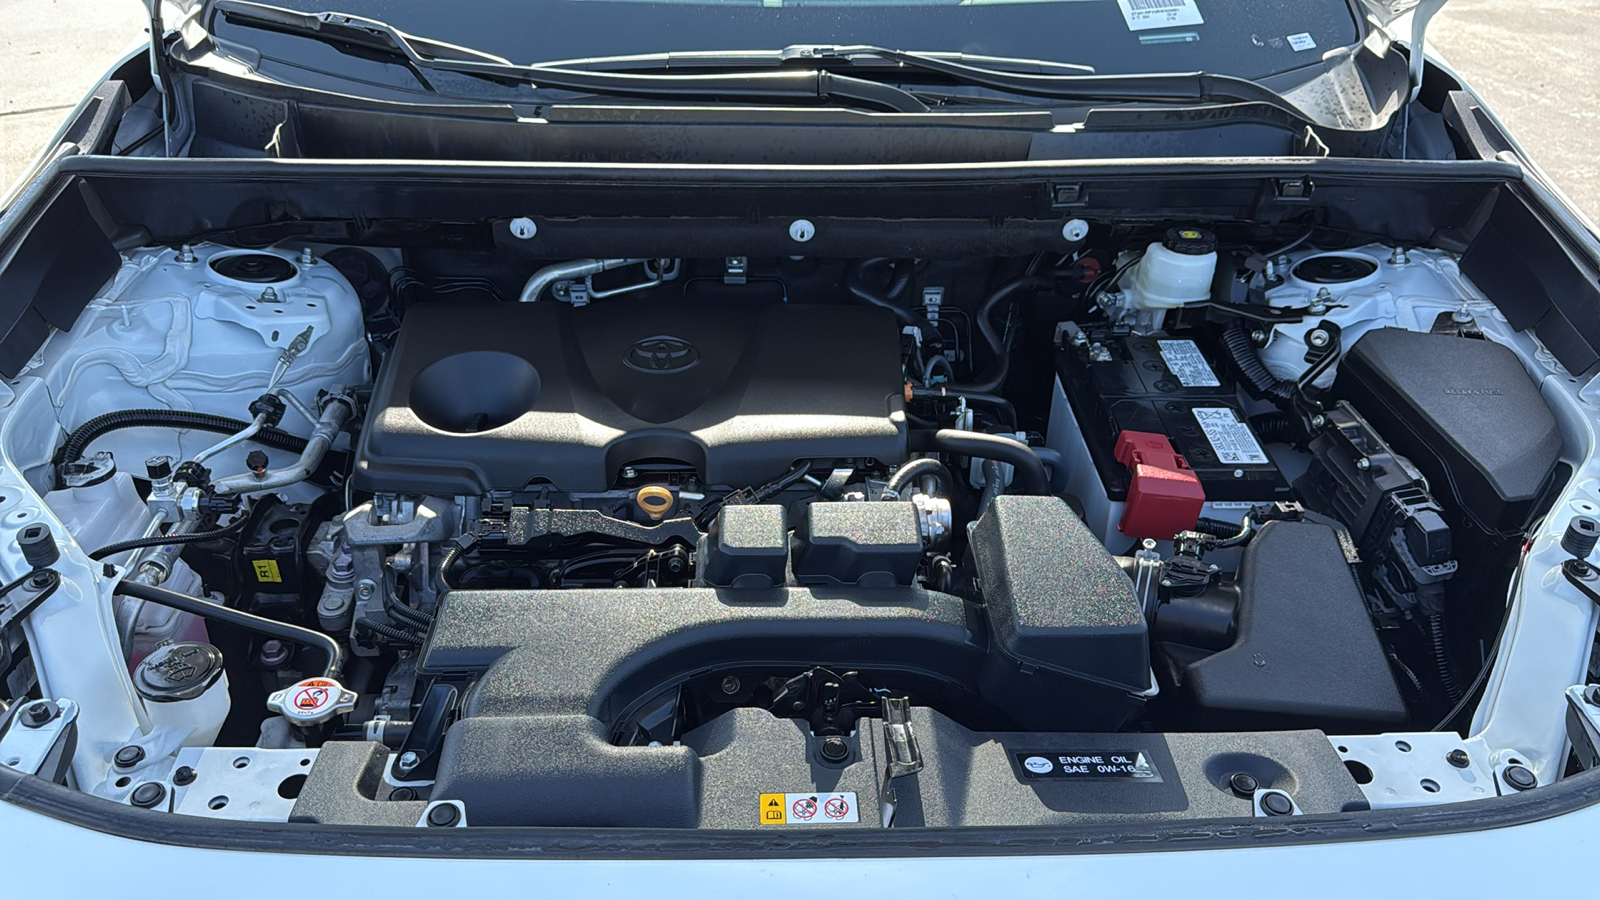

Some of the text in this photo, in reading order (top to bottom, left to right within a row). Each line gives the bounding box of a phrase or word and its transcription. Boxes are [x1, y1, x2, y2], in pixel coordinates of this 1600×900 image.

[257, 564, 270, 578] R1
[1058, 756, 1133, 764] ENGINE OIL
[1063, 765, 1136, 773] SAE 0W-16
